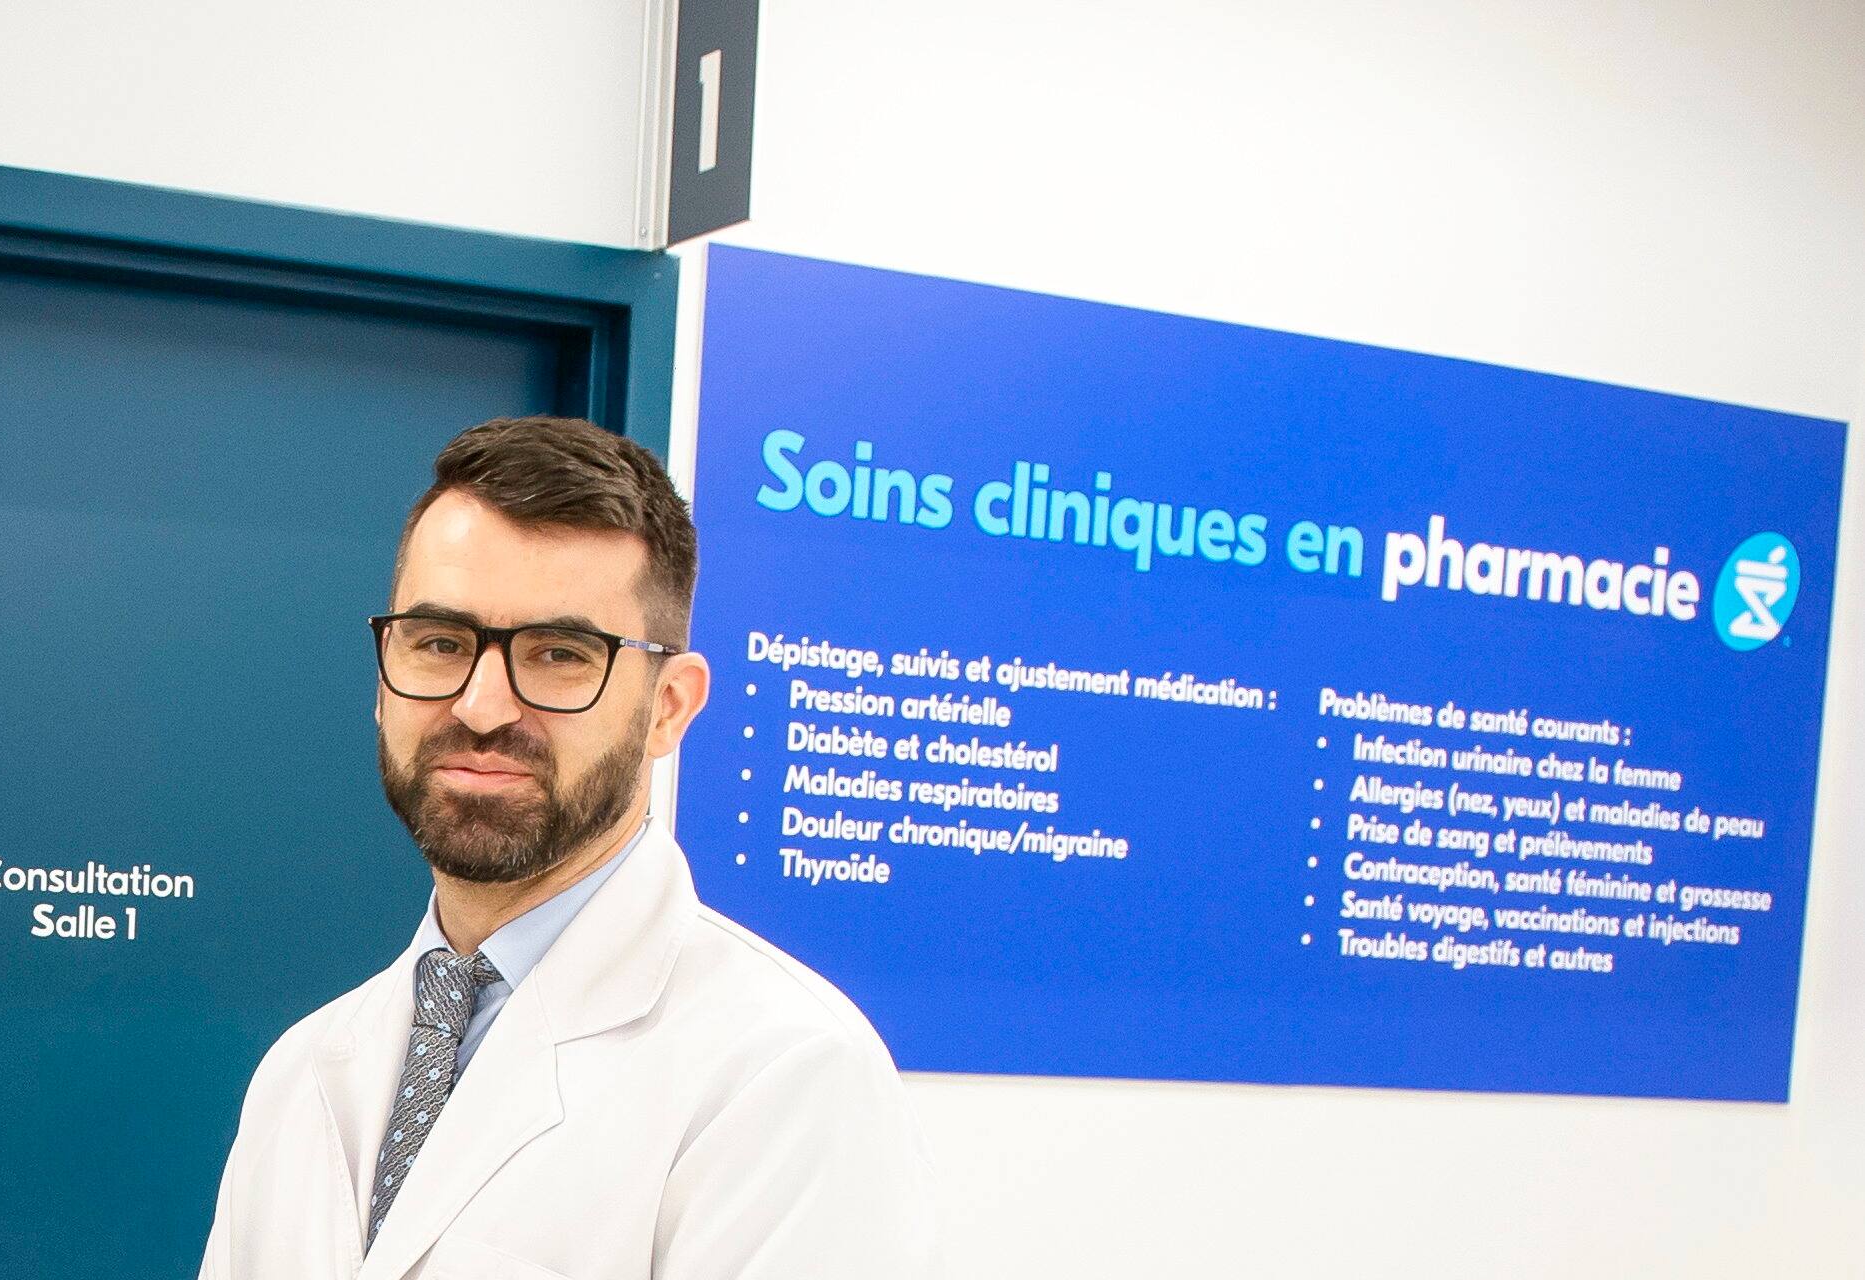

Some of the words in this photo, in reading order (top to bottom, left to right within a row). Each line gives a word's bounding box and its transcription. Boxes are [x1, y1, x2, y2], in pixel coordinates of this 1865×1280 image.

[697, 48, 723, 175] 1
[756, 429, 954, 529] Soins
[973, 460, 1268, 572] cliniques
[1286, 520, 1364, 577] en
[1381, 514, 1701, 621] pharmacie
[747, 631, 885, 679] Dépistage,
[890, 647, 961, 681] suivis
[964, 655, 992, 683] et
[995, 656, 1131, 696] ajustement
[1134, 671, 1264, 709] médication
[789, 679, 895, 717] Pression
[900, 692, 1012, 728] artérielle
[1319, 687, 1434, 727] Problèmes
[1436, 700, 1467, 730] de
[1469, 708, 1529, 736] santé
[1531, 717, 1620, 746] courants
[787, 721, 889, 759] Diabète
[893, 733, 921, 761] et
[924, 734, 1059, 773] cholestérol
[1353, 732, 1448, 769] Infection
[1451, 744, 1534, 777] urinaire
[1536, 752, 1585, 782] chez
[1588, 756, 1610, 785] la
[1613, 758, 1683, 792] femme
[783, 764, 903, 802] Maladies
[908, 777, 1059, 814] respiratoires
[1349, 774, 1445, 814] Allergies
[1447, 782, 1499, 818] (nez,
[1502, 791, 1561, 826] yeux)
[1564, 797, 1587, 822] et
[1590, 800, 1681, 832] maladies
[1683, 806, 1711, 834] de
[1714, 815, 1765, 840] peau
[781, 806, 884, 842] Douleur
[888, 814, 1129, 863] chronique/migraine
[1347, 813, 1400, 845] Prise
[1403, 818, 1434, 847] de
[1437, 828, 1490, 858] sang
[1493, 828, 1517, 854] et
[1519, 830, 1654, 866] prélèvements
[779, 847, 891, 886] Thyroïde
[1344, 851, 1501, 894] Contraception,
[1504, 868, 1563, 895] santé
[1566, 869, 1653, 902] féminine
[1655, 879, 1678, 904] et
[1679, 885, 1773, 912] grossesse
[30, 903, 117, 940] Salle
[125, 907, 137, 940] 1
[1340, 889, 1404, 922] Santé
[1407, 902, 1490, 933] voyage,
[1494, 904, 1621, 937] vaccinations
[1623, 913, 1646, 938] et
[1648, 912, 1741, 946] injections
[1338, 928, 1429, 961] Troubles
[1431, 935, 1521, 970] digestifs
[1523, 943, 1547, 968] et
[1549, 946, 1614, 973] autres
